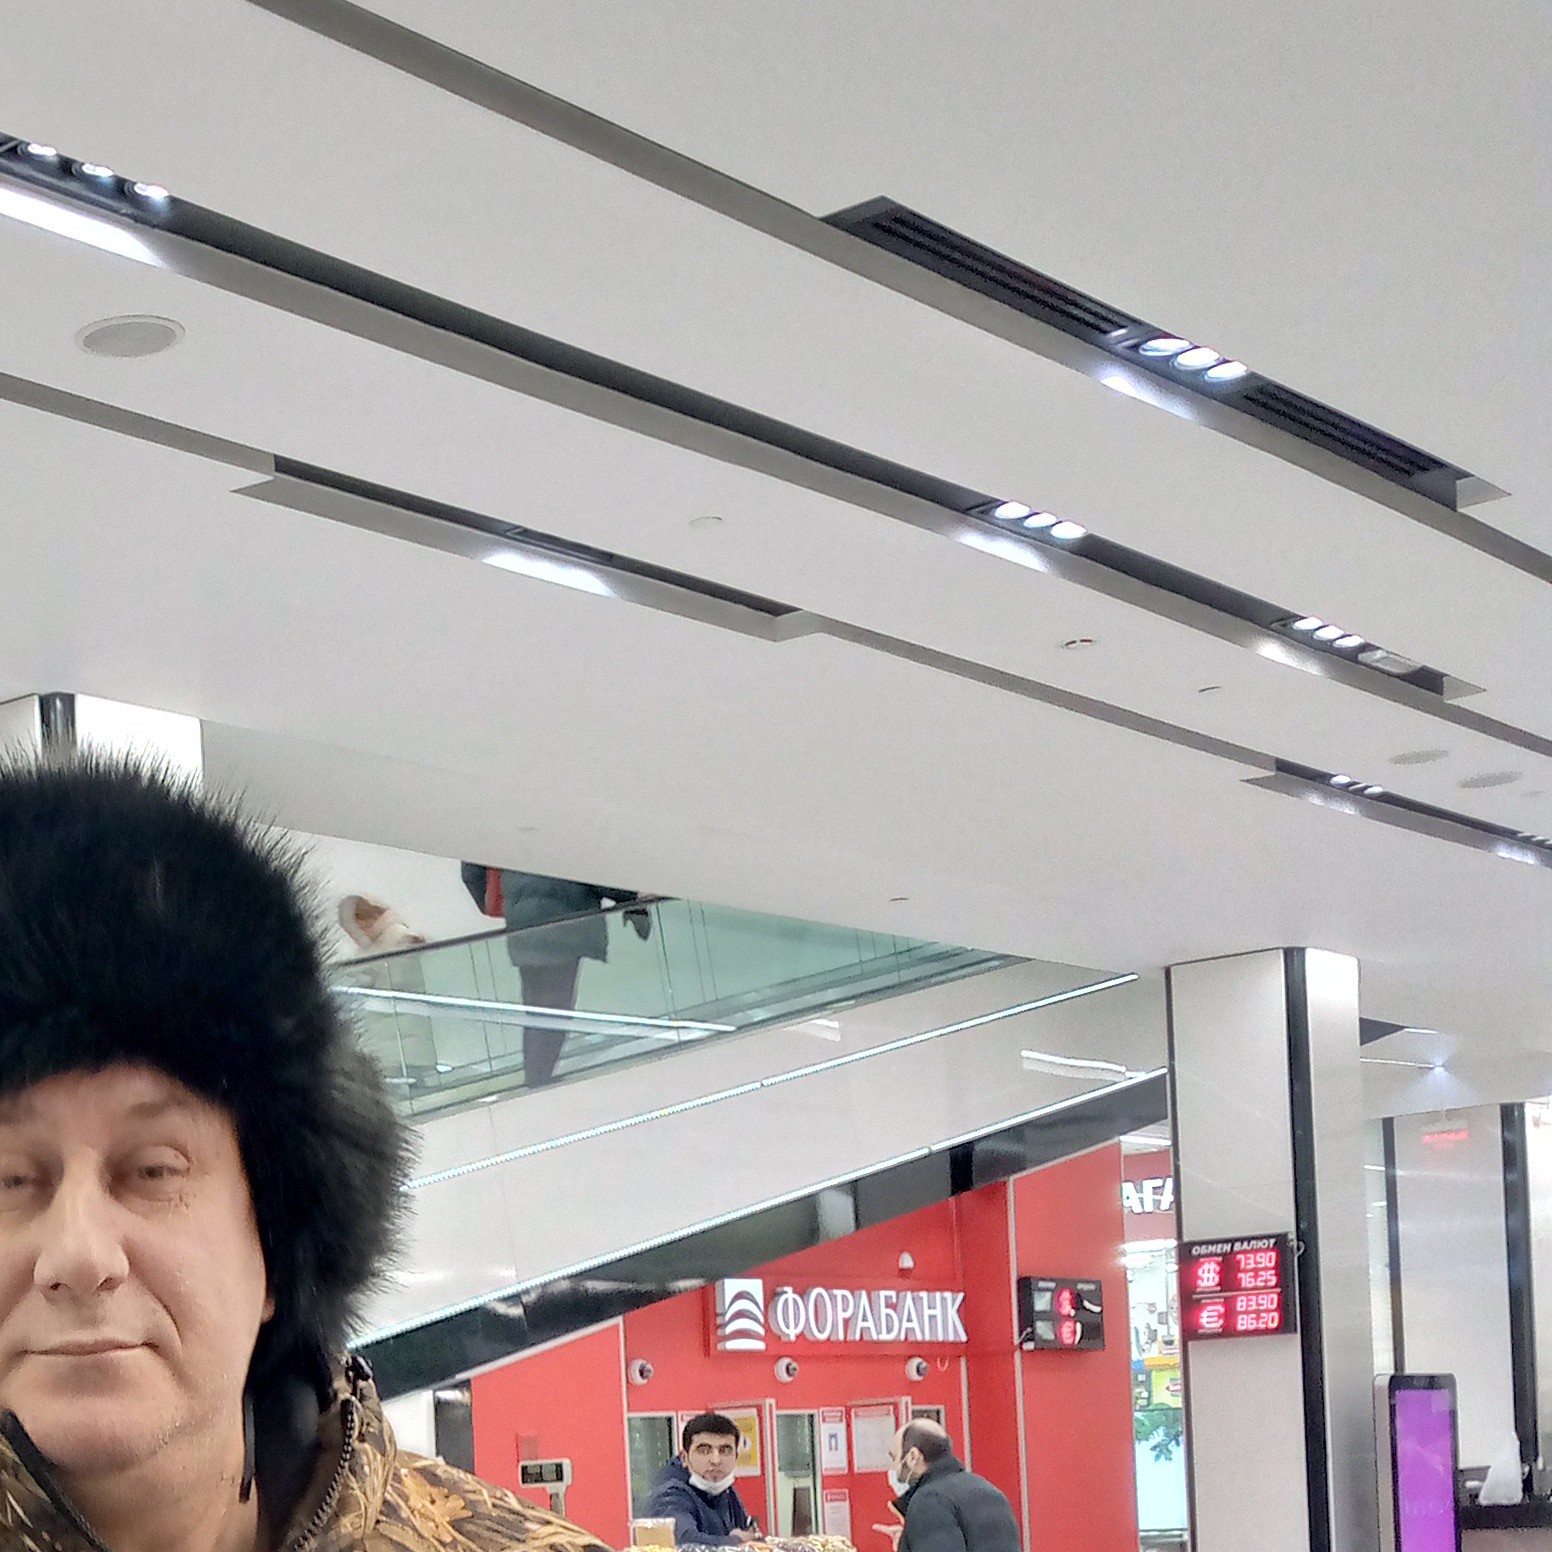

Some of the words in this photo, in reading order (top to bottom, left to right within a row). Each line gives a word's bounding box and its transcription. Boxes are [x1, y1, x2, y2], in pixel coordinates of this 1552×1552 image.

[1191, 1243, 1232, 1256] ОБМЕН
[1233, 1238, 1276, 1251] ВАЛЮТ
[770, 1286, 968, 1342] ФОРАБАНК
